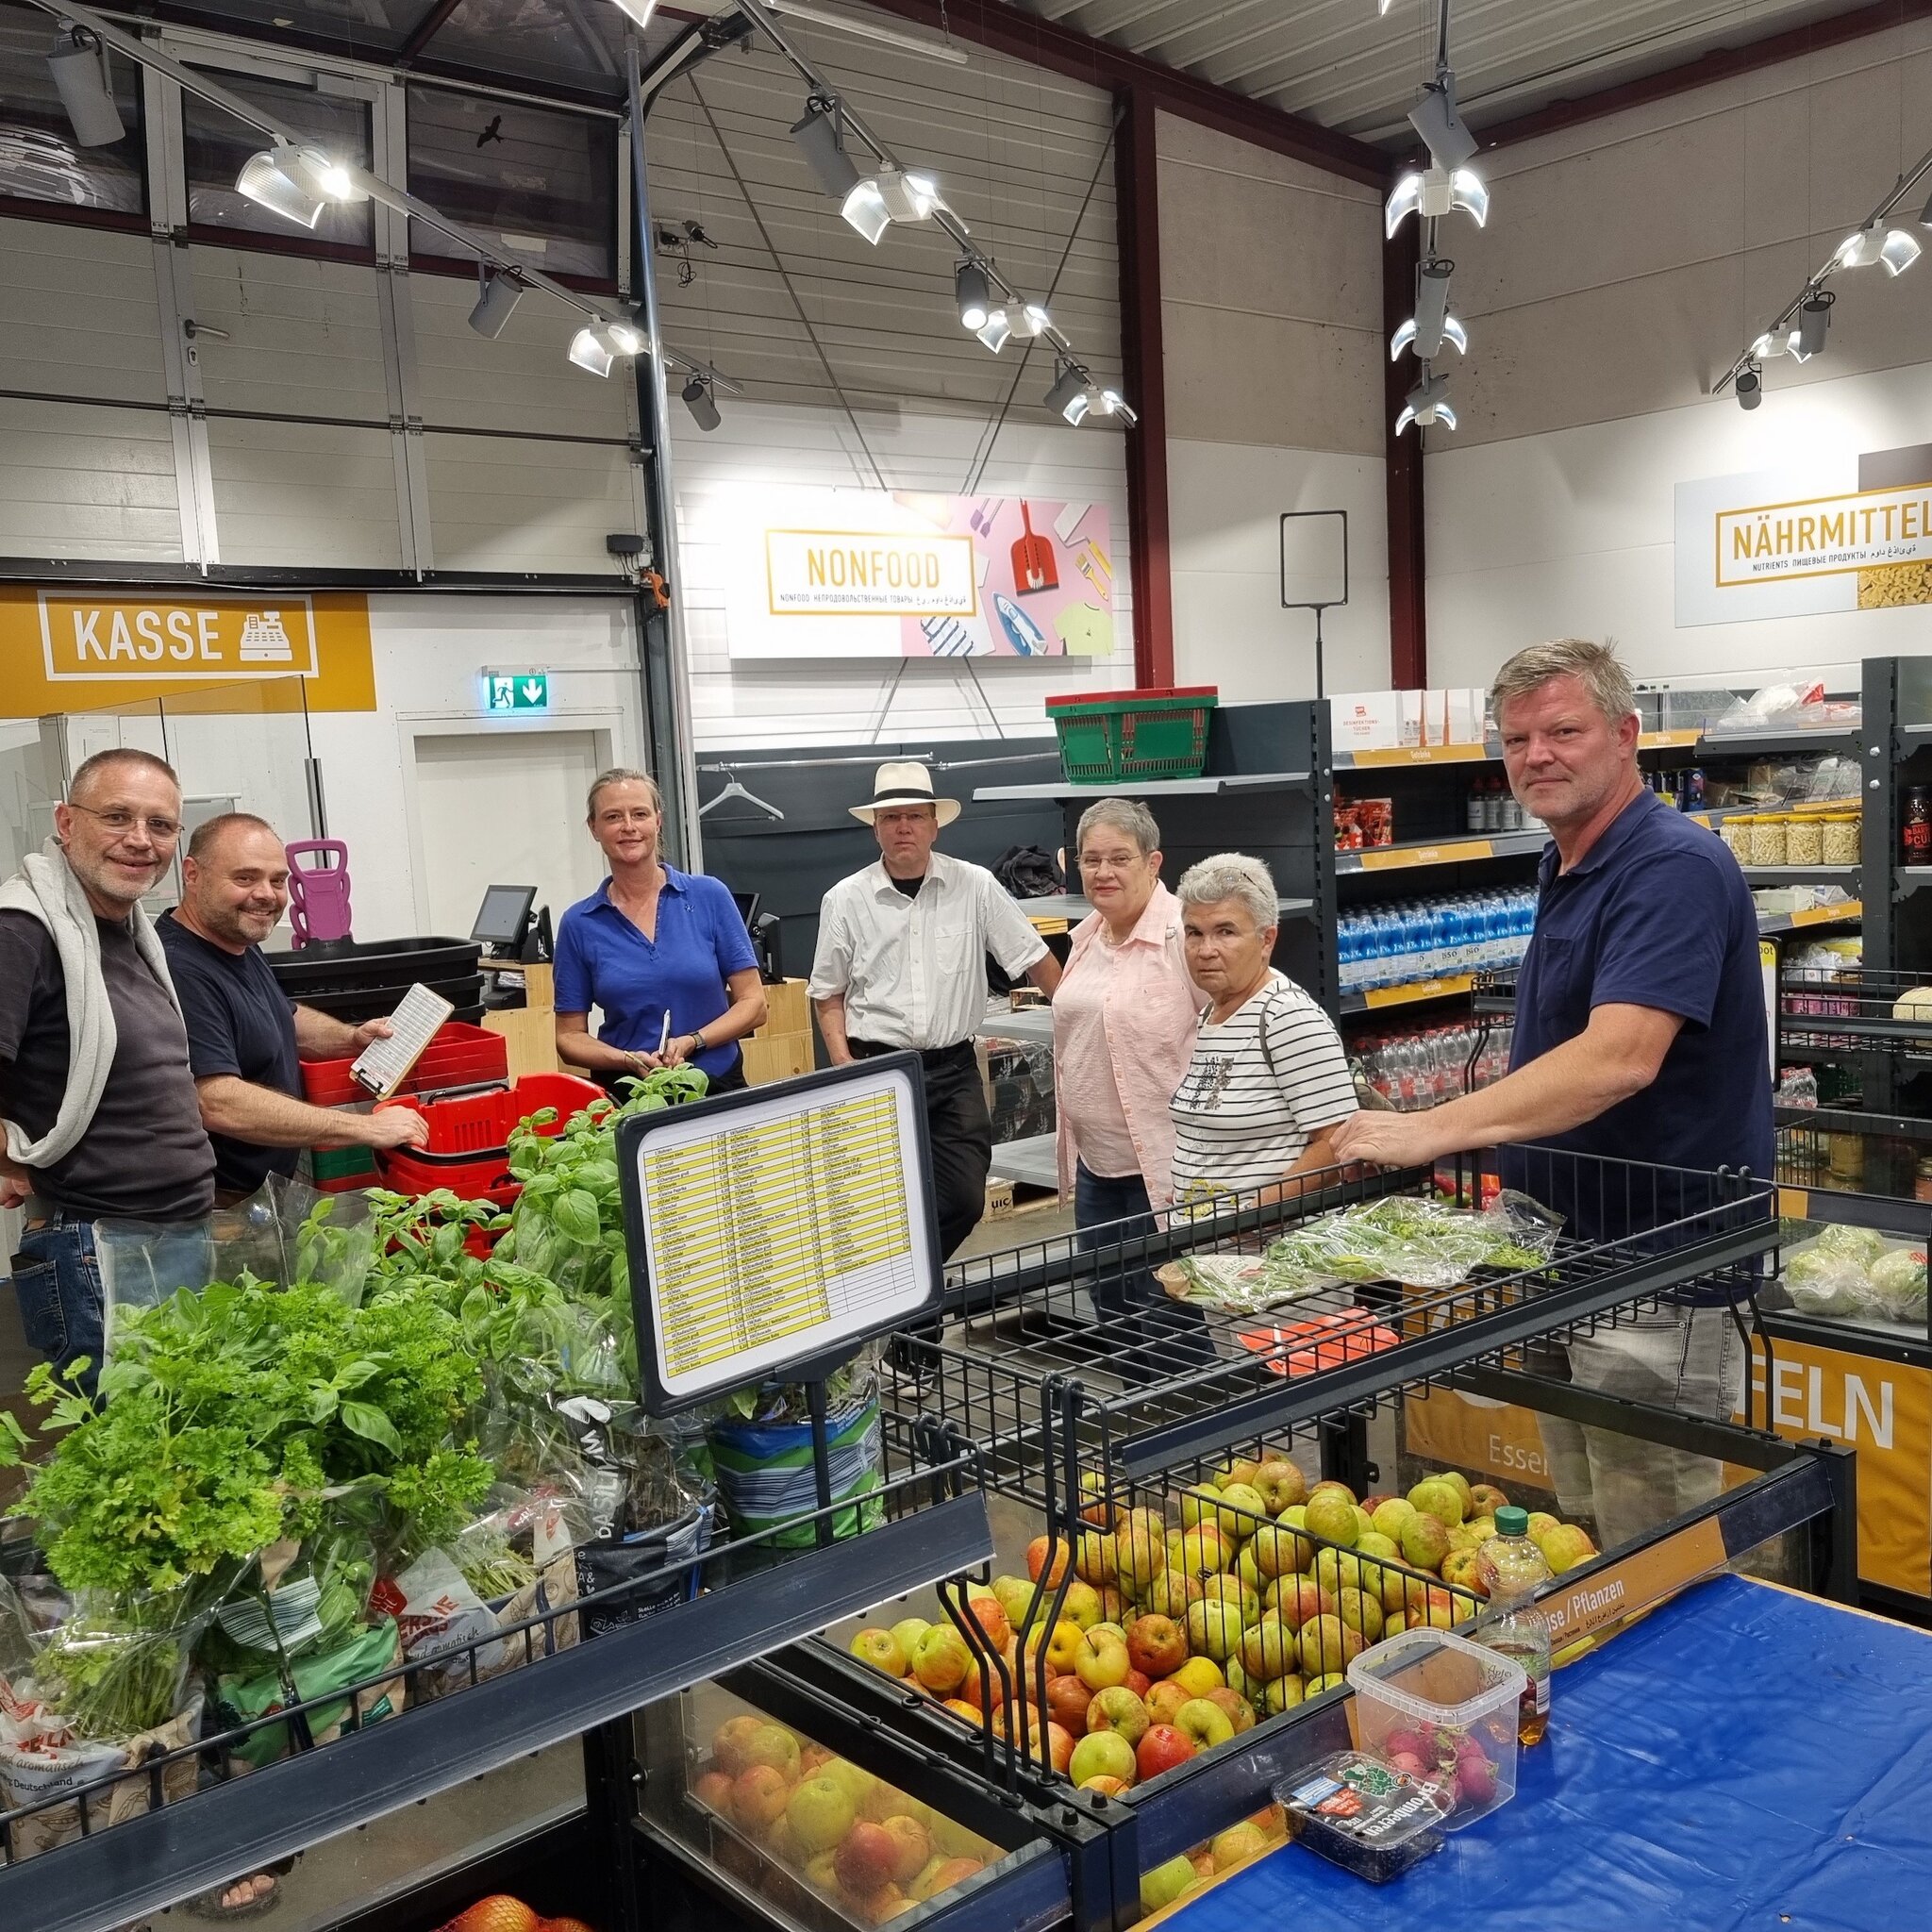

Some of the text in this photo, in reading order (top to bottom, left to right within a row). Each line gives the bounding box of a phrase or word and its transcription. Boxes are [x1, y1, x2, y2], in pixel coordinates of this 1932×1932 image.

[1733, 500, 1932, 559] NÄHRMITTEL
[808, 549, 940, 589] NONFOOD
[1753, 560, 1789, 572] NUTRIENTS
[1792, 551, 1867, 567] ПИЩЕВЫЕ ПРОДУКТЫ
[780, 593, 810, 602] NONFOOD
[73, 610, 223, 660] KASSE
[1572, 1579, 1624, 1619] Pflanzen
[16, 1755, 85, 1774] aromatisch
[1362, 1781, 1440, 1838] Brombeeren
